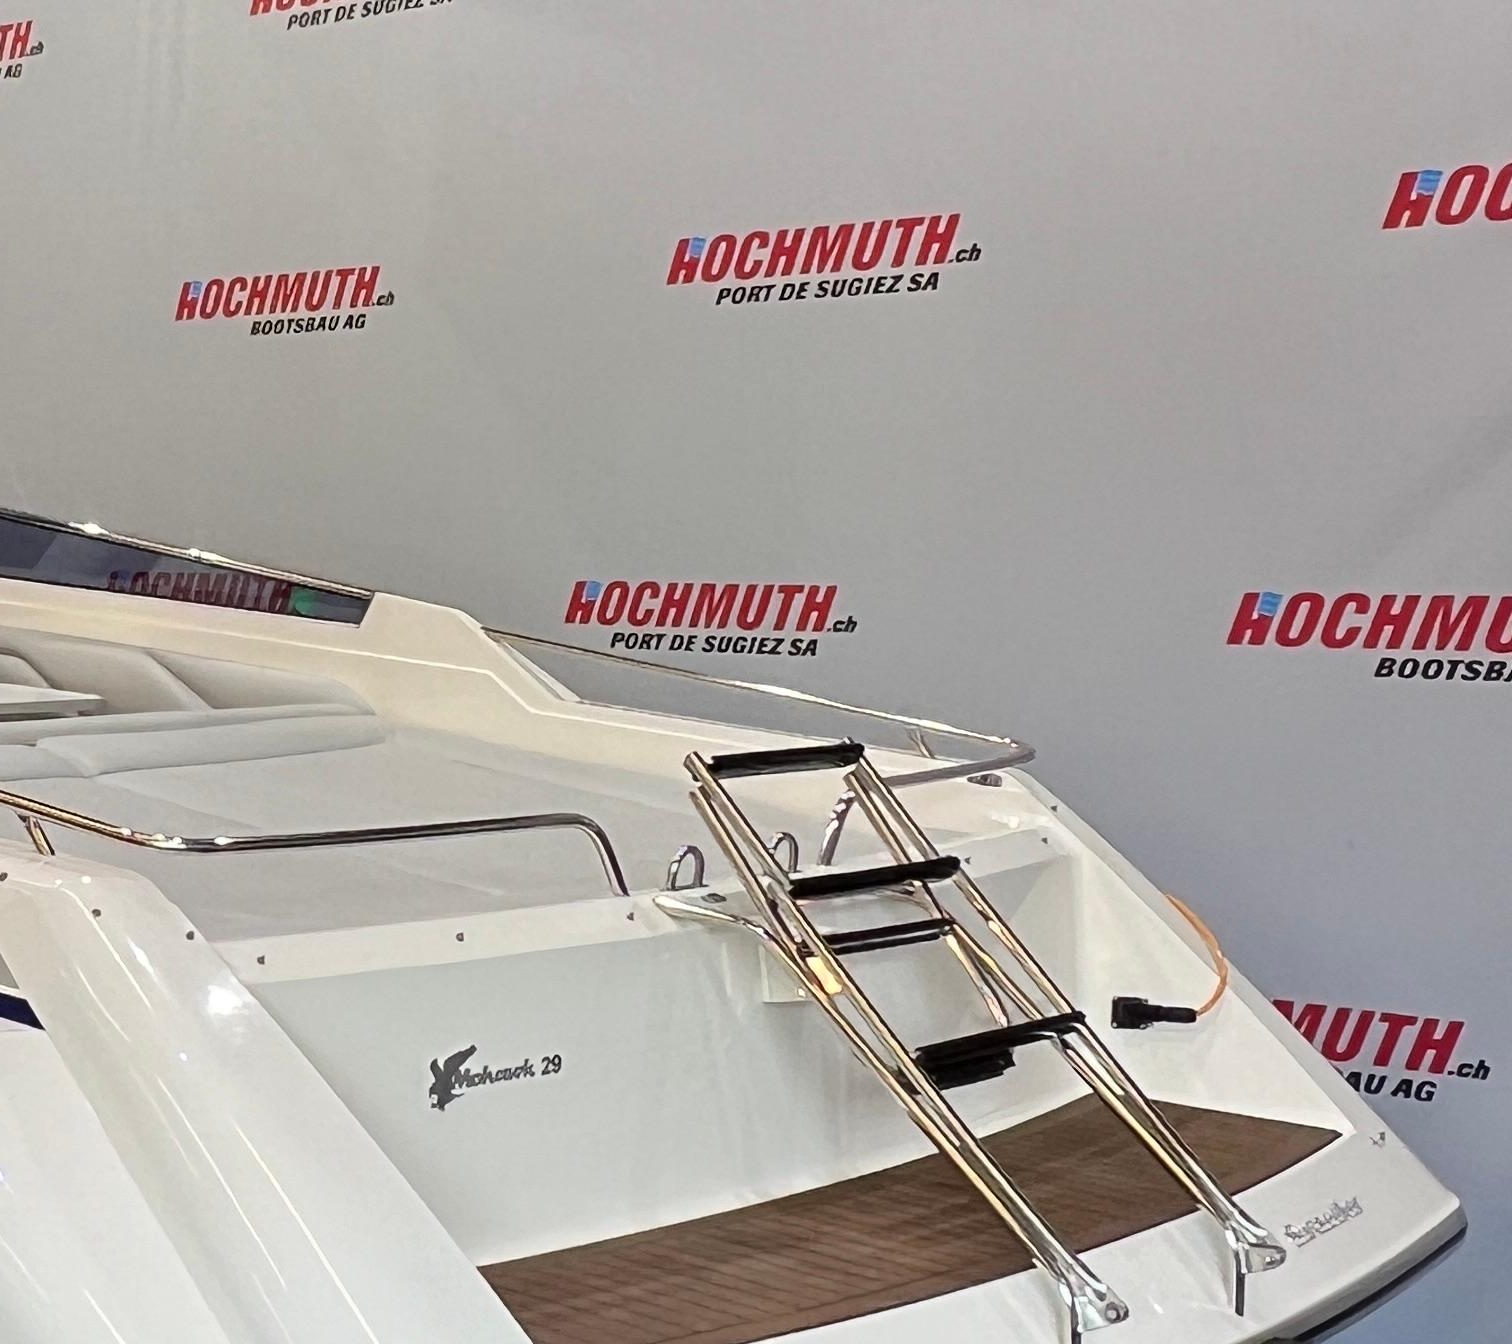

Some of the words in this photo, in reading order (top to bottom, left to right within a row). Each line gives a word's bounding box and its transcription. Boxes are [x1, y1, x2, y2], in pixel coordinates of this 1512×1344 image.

[287, 6, 333, 31] PORT
[334, 4, 358, 23] DE
[666, 212, 982, 286] HOCHMUTH.ch
[175, 265, 395, 322] HOCHMUTH.ch
[715, 284, 776, 306] PORT
[778, 282, 811, 302] DE
[813, 274, 904, 299] SUGIEZ
[906, 272, 940, 293] SA
[250, 315, 341, 336] BOOTSBAU
[342, 313, 367, 330] AG
[564, 580, 858, 634] HOCHMUTH.ch
[610, 632, 666, 651] PORT
[668, 634, 698, 652] DE
[701, 635, 785, 655] SUGIEZ
[787, 637, 819, 657] SA
[1374, 657, 1512, 683] BOOTSB
[541, 1054, 562, 1075] 29
[1336, 1068, 1388, 1095] AU
[1390, 1078, 1438, 1102] AG
